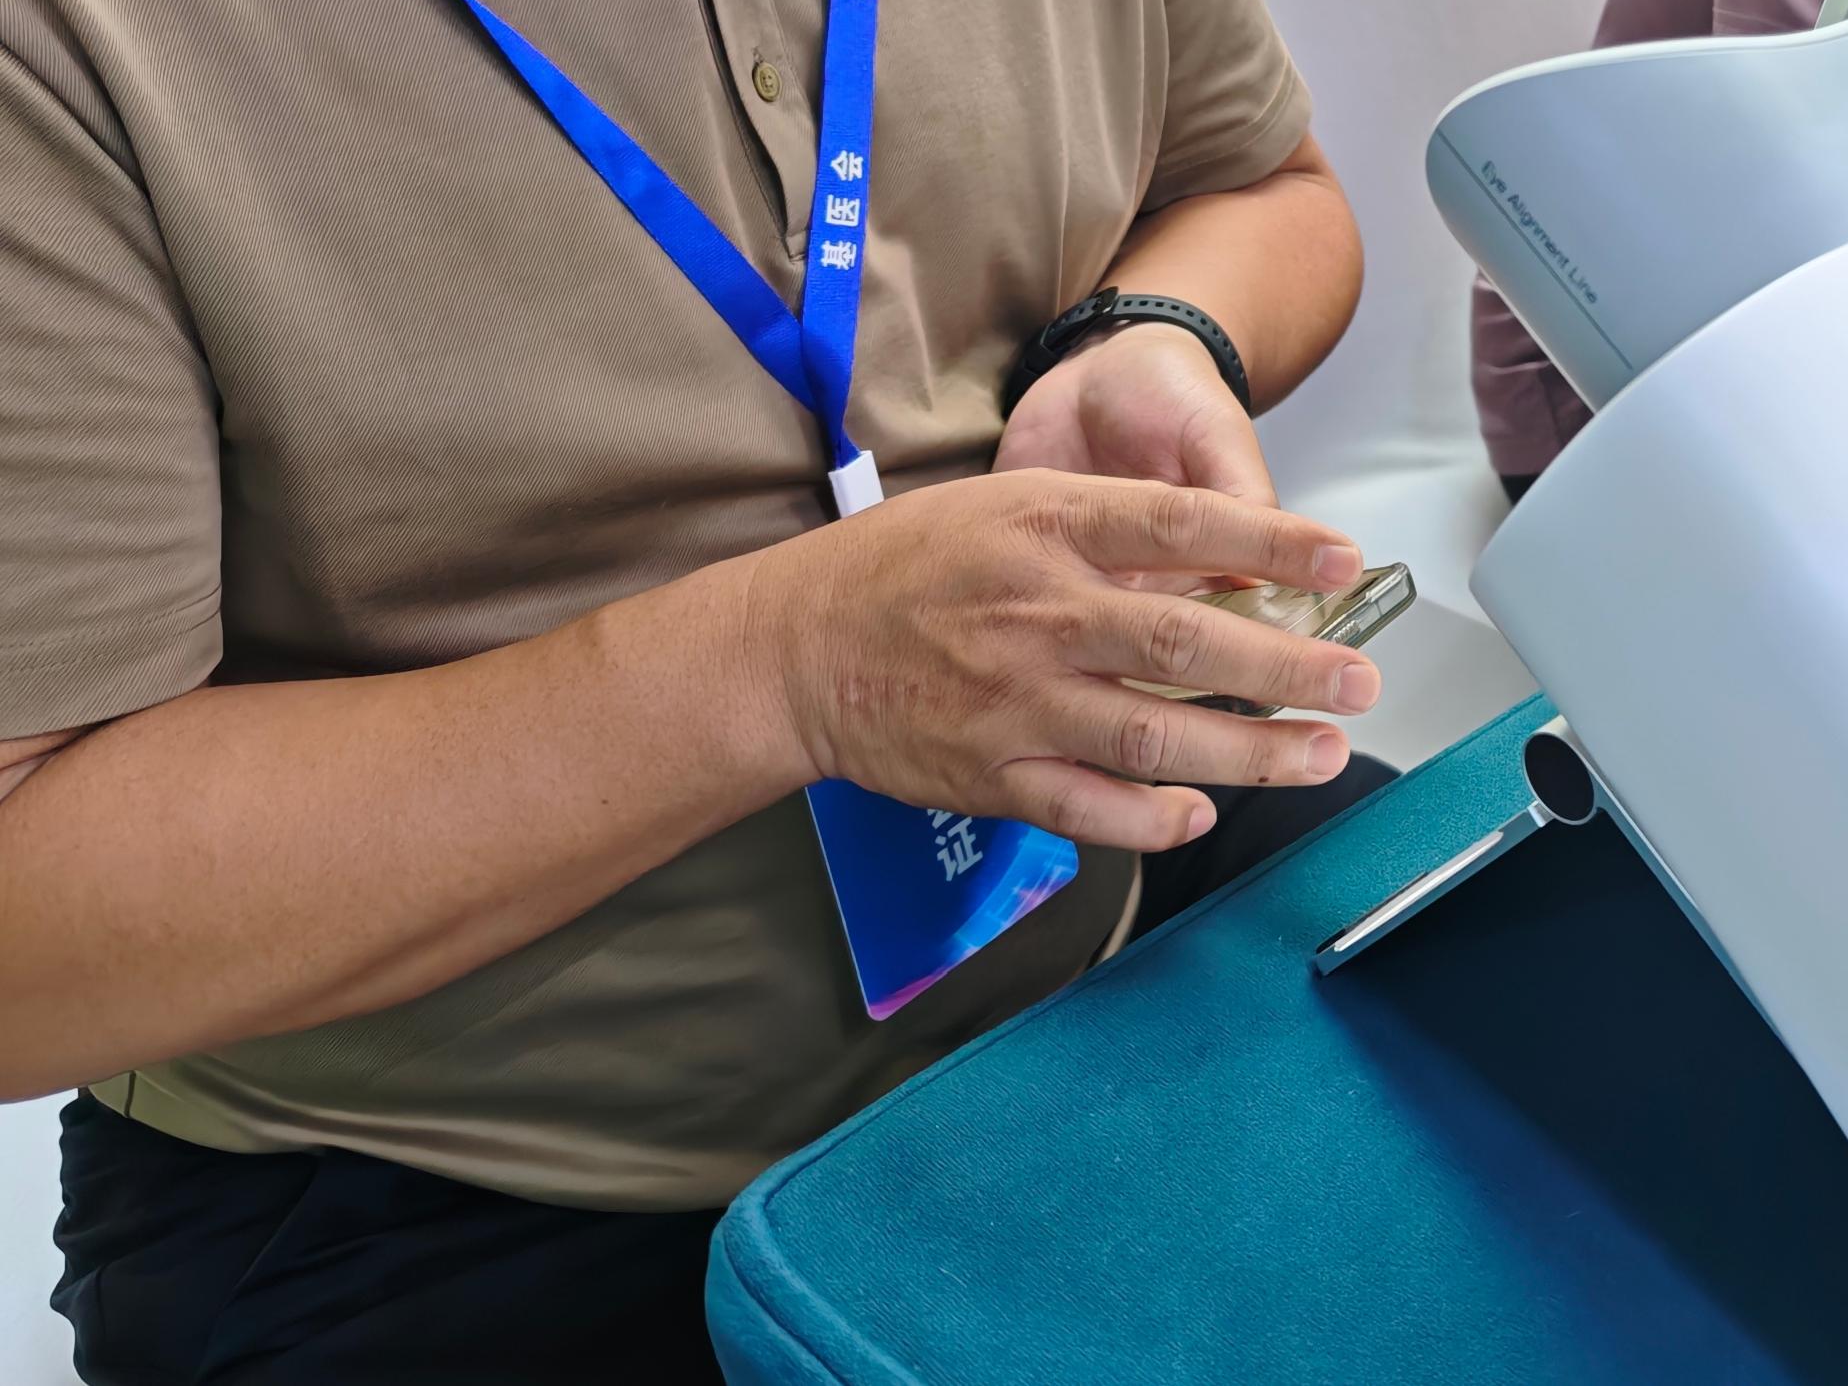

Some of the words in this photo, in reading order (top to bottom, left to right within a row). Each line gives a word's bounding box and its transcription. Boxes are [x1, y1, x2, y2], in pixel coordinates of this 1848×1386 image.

[820, 149, 865, 270] 基医会
[1507, 193, 1570, 270] Alignment
[1568, 266, 1598, 305] Line
